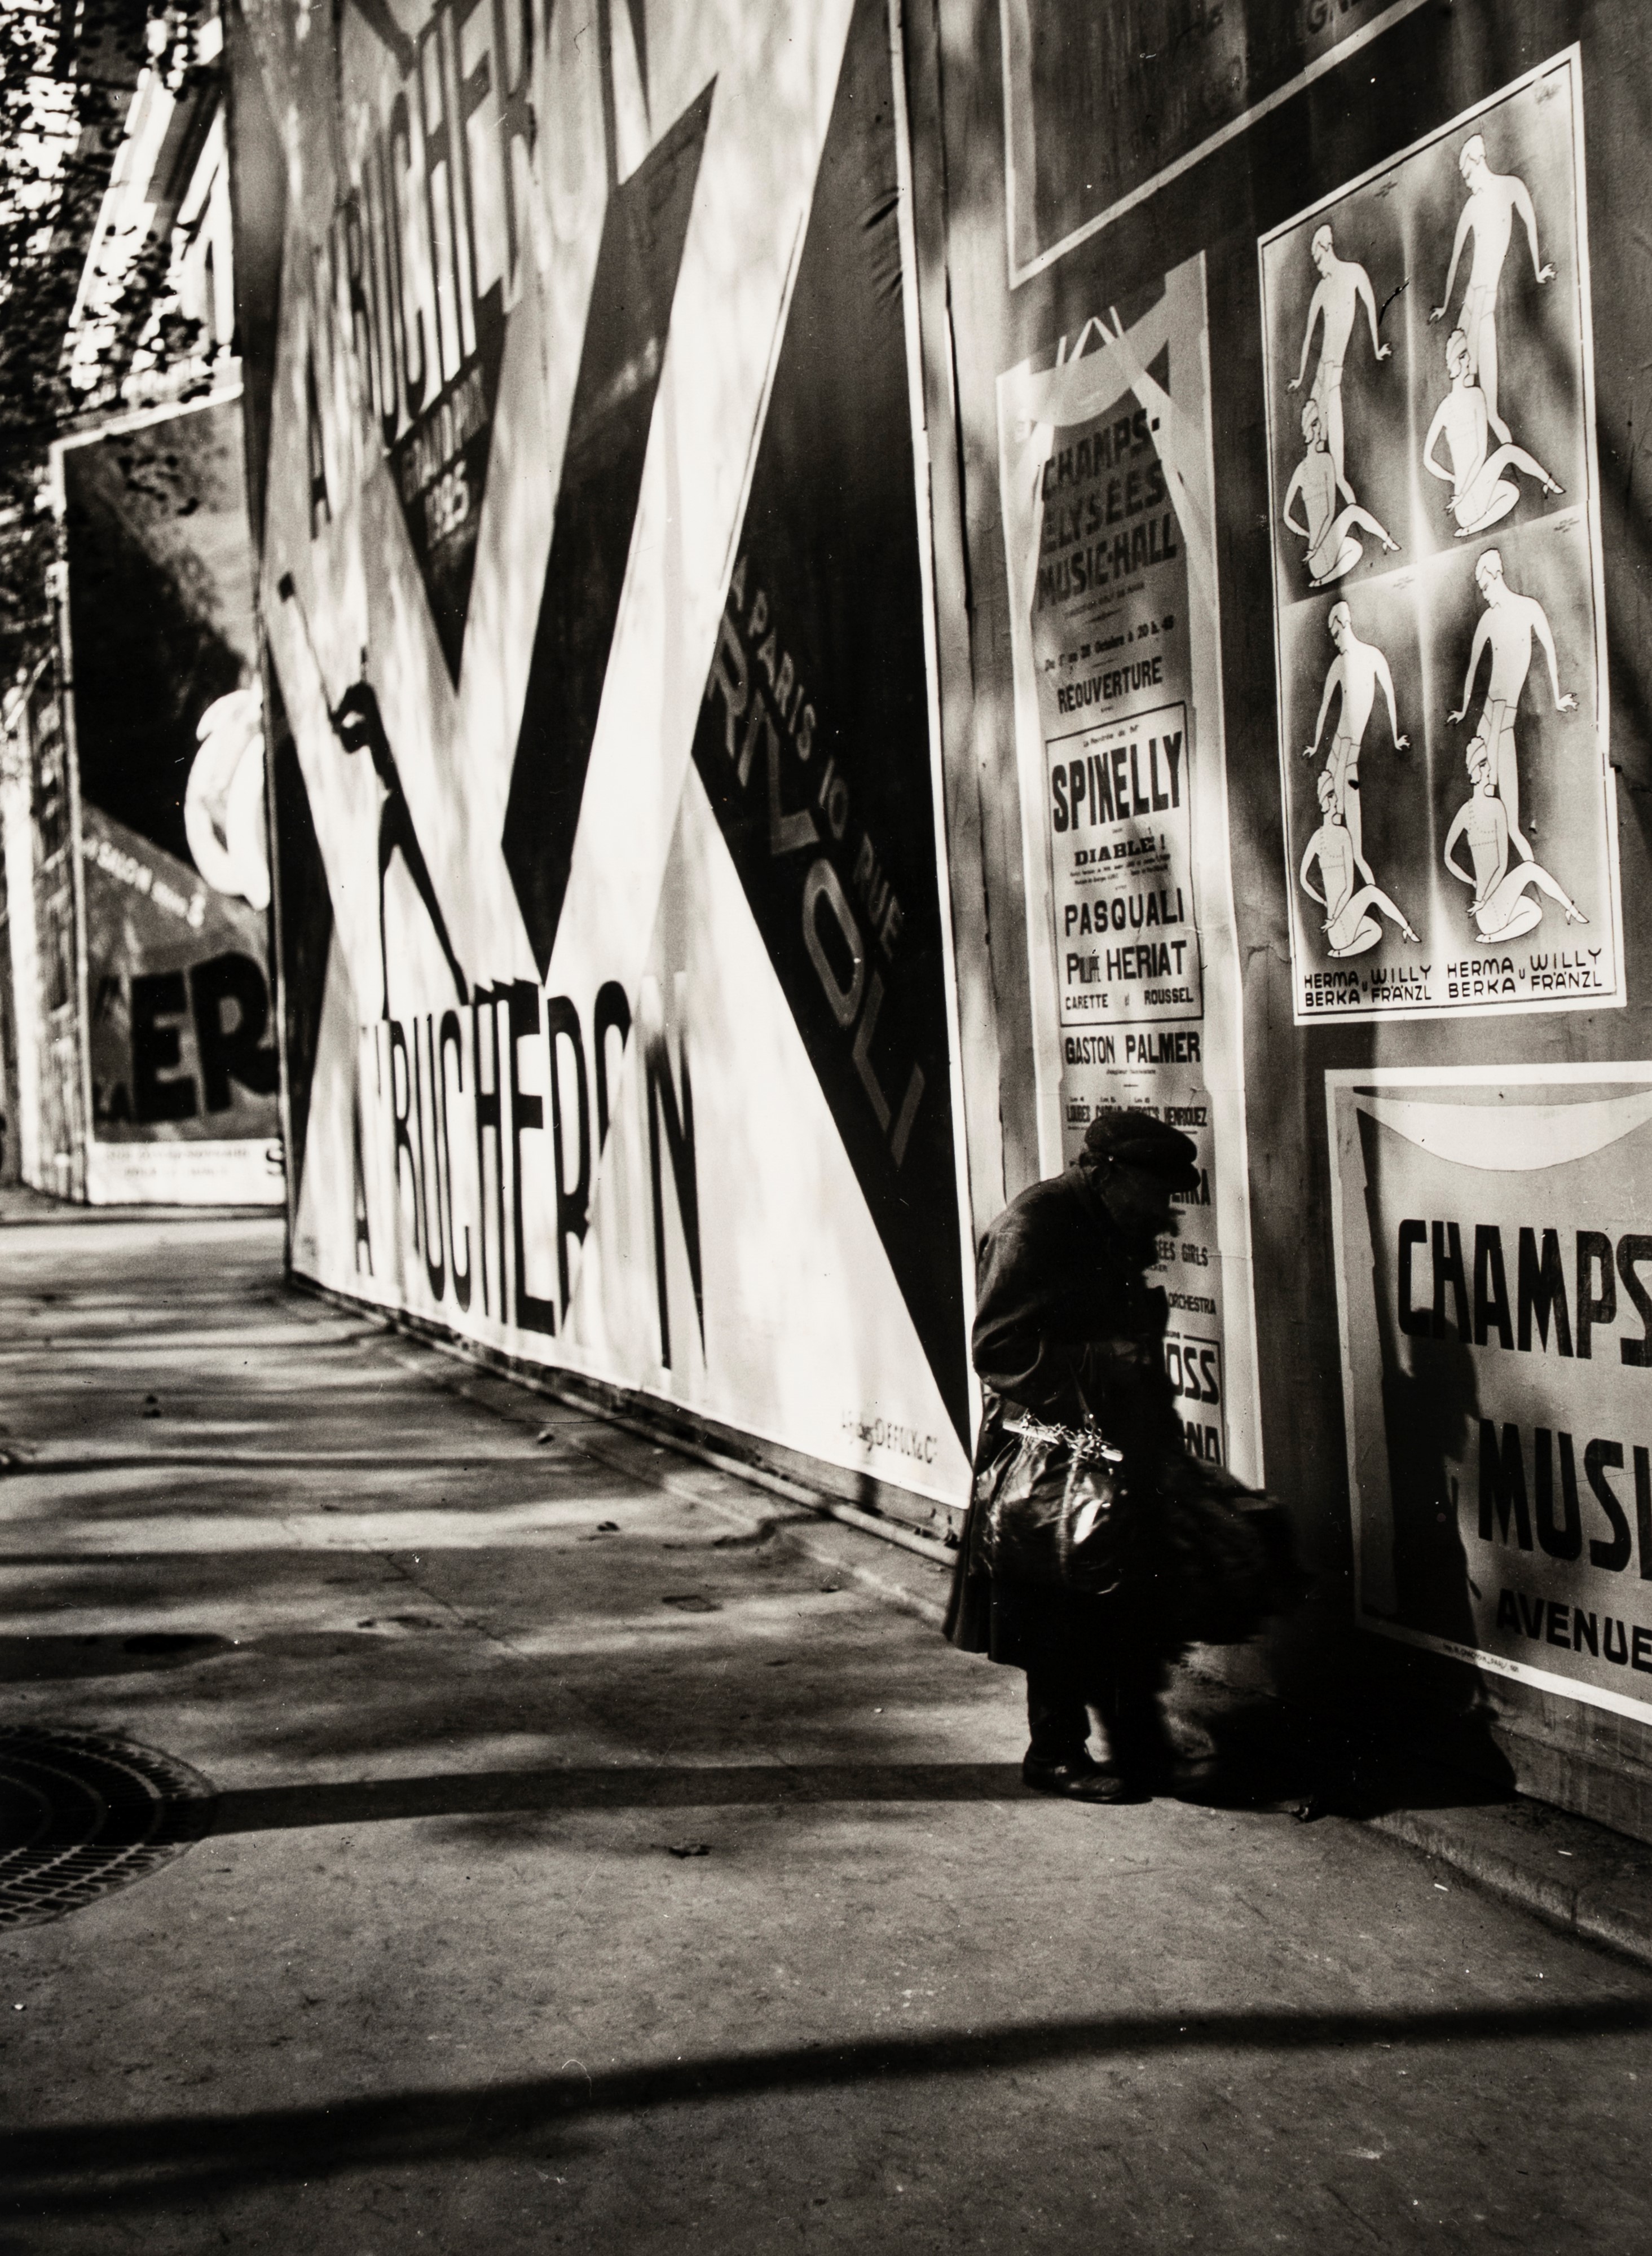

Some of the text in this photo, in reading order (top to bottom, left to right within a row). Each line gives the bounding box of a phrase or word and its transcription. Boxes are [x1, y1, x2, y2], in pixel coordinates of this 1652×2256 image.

[1051, 731, 1182, 832] SPINELLY
[1064, 888, 1184, 937] PASQUALI
[1107, 940, 1187, 981] HERIAT
[1304, 970, 1359, 989] HERMA
[1371, 964, 1431, 985] WILLY
[1447, 957, 1514, 979] HERMA
[1530, 948, 1602, 972] WILLY
[1065, 993, 1109, 1011] CARETTE
[1144, 986, 1194, 1006] ROUSSEL
[1305, 989, 1360, 1007] BERKA
[1448, 977, 1516, 998] BERKA
[1065, 1031, 1201, 1065] GASTON PALMER
[1398, 1219, 1652, 1368] CHAMPS
[1496, 1588, 1652, 1674] AVENUE
